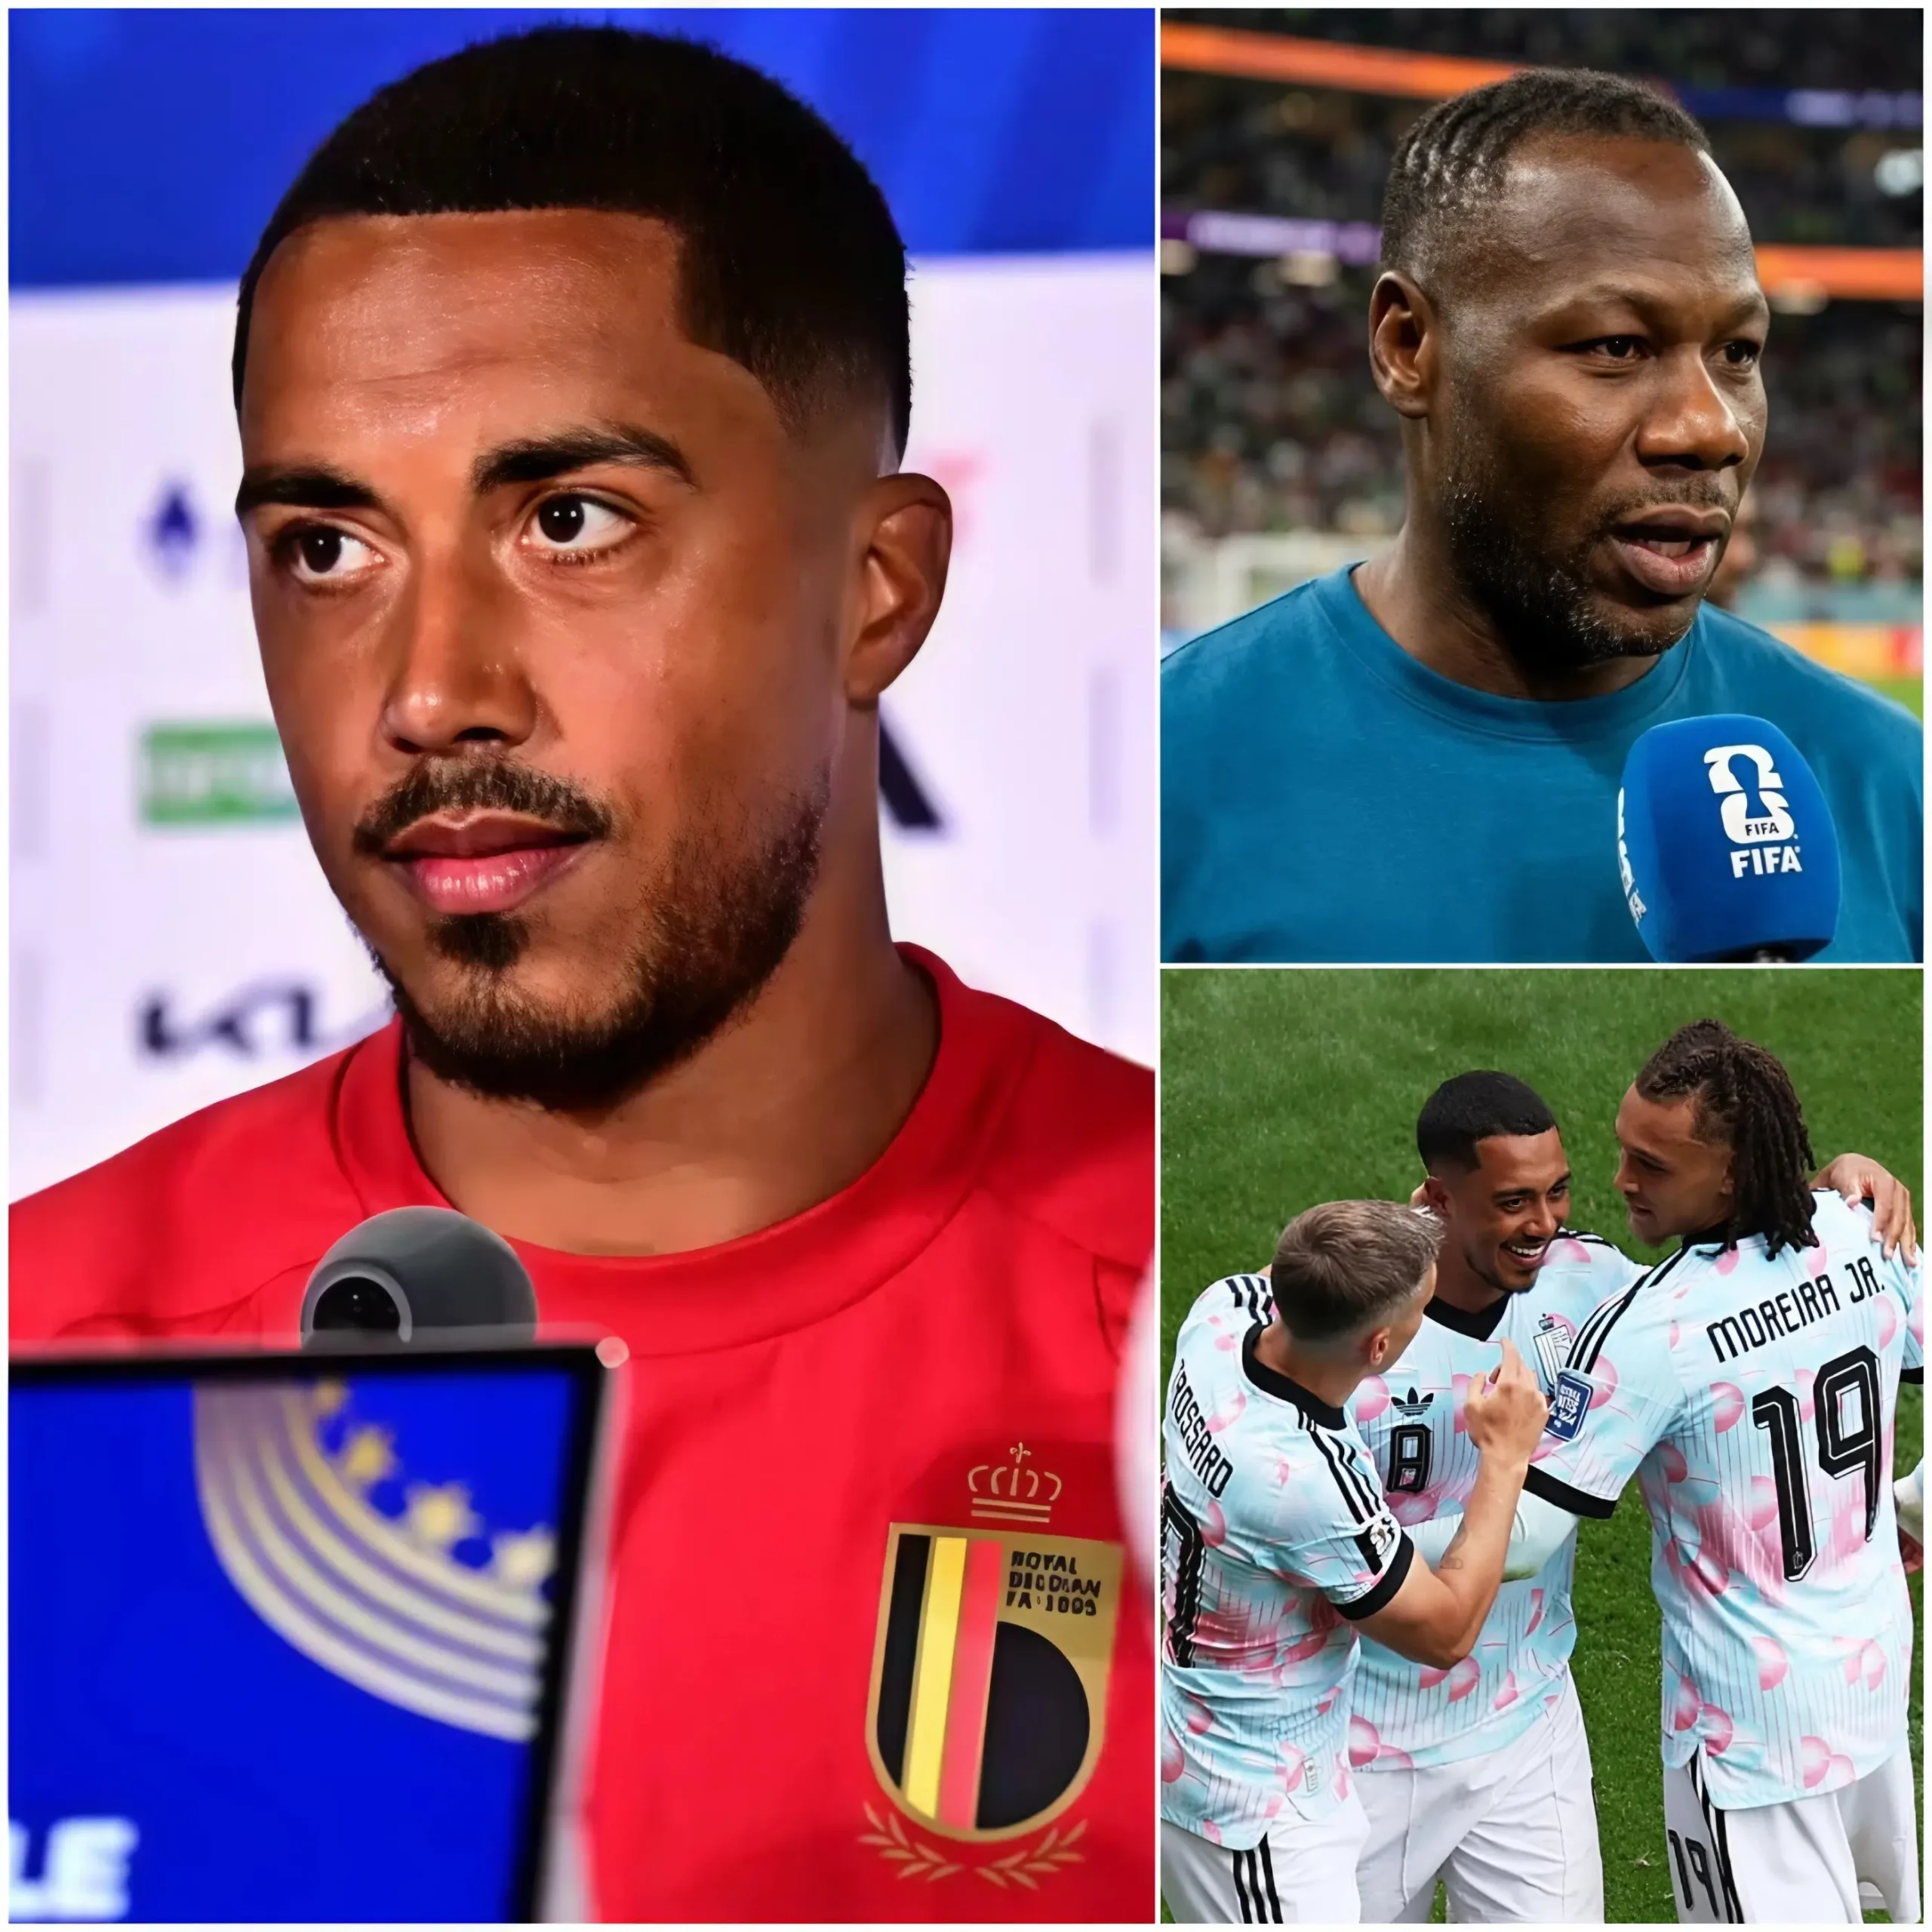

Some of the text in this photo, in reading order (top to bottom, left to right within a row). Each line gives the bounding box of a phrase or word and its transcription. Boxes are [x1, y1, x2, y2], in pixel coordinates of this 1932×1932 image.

[1730, 846, 1802, 878] FIFA
[1745, 822, 1780, 835] FIFA
[1706, 1256, 1885, 1363] MOREIRA JR.
[1386, 1423, 1434, 1494] 8
[1752, 1345, 1881, 1582] 19
[1668, 1829, 1719, 1919] 19
